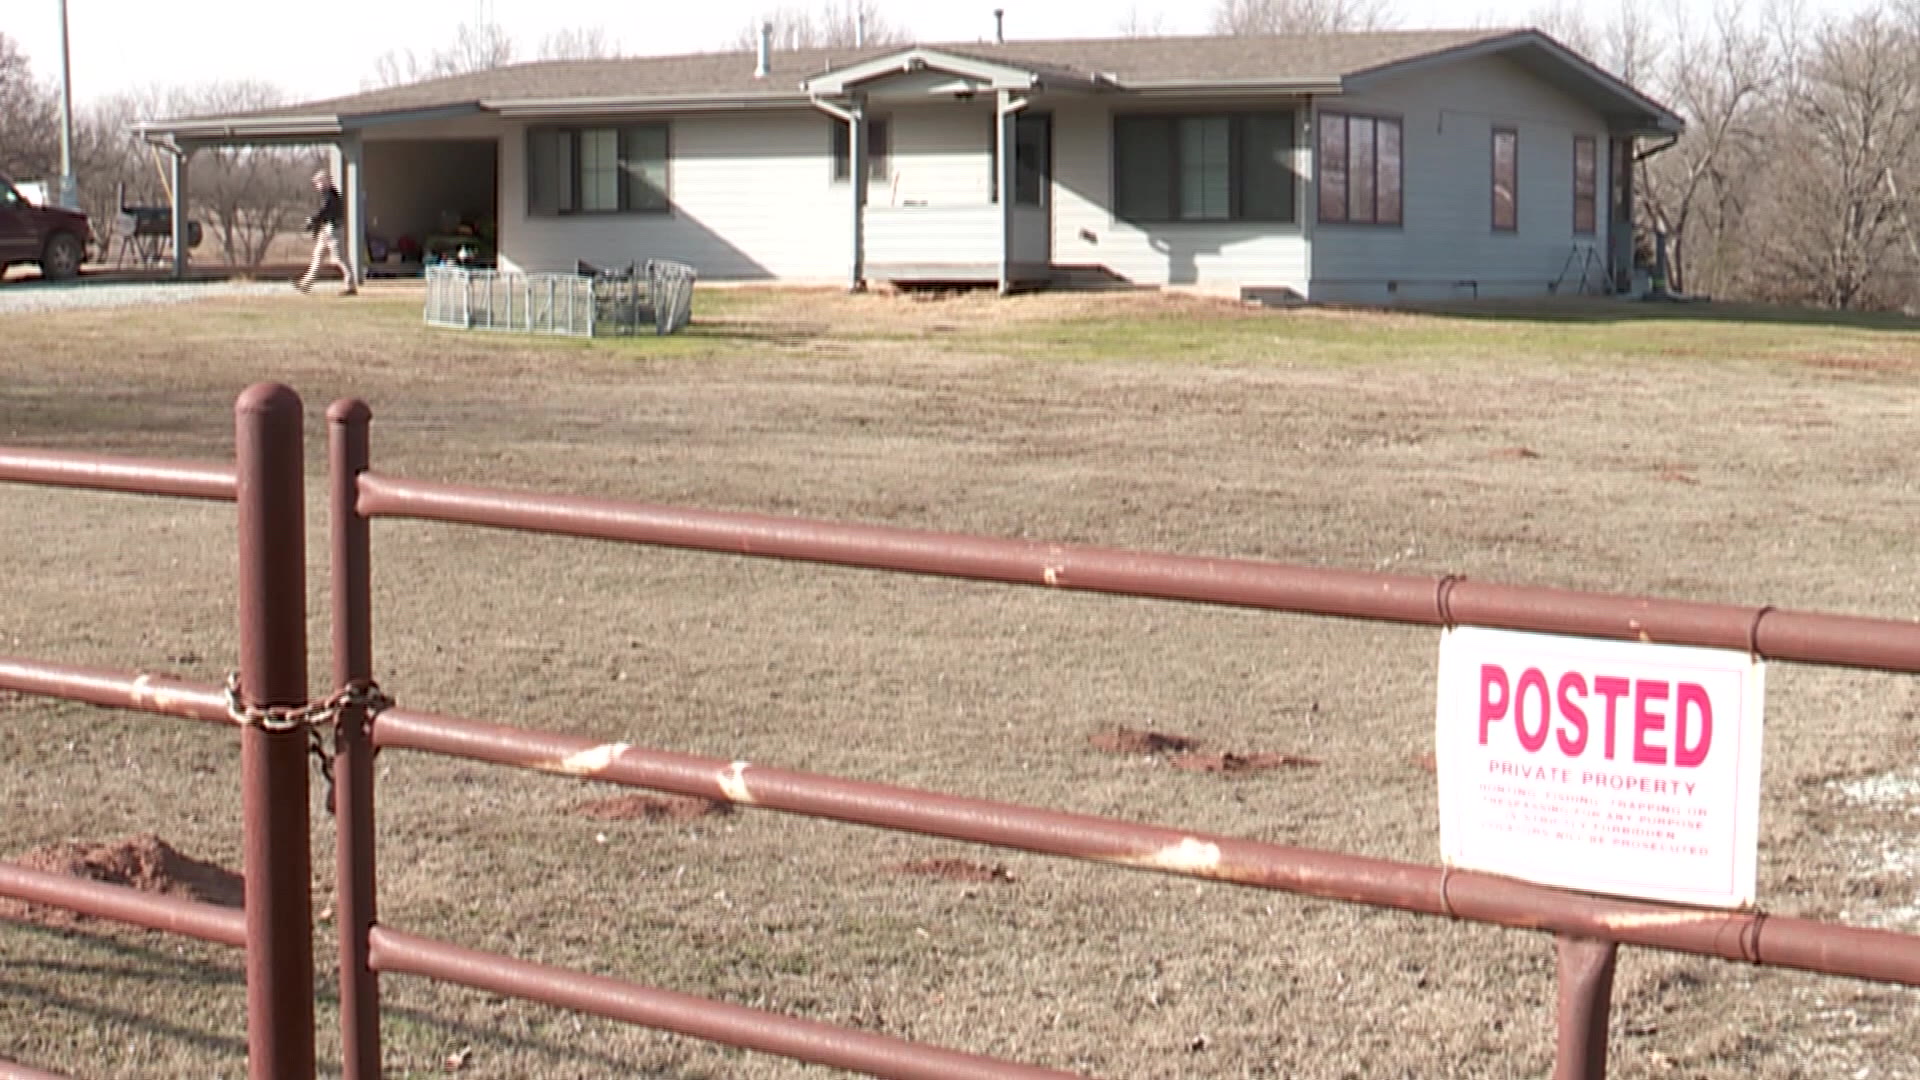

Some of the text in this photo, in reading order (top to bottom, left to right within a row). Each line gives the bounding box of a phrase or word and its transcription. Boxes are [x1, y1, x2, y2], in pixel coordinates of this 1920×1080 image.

[1478, 663, 1714, 768] POSTED
[1489, 759, 1697, 797] PRIVATE PROPERTY
[1606, 812, 1632, 823] ANY
[1639, 815, 1704, 831] PURPOSE
